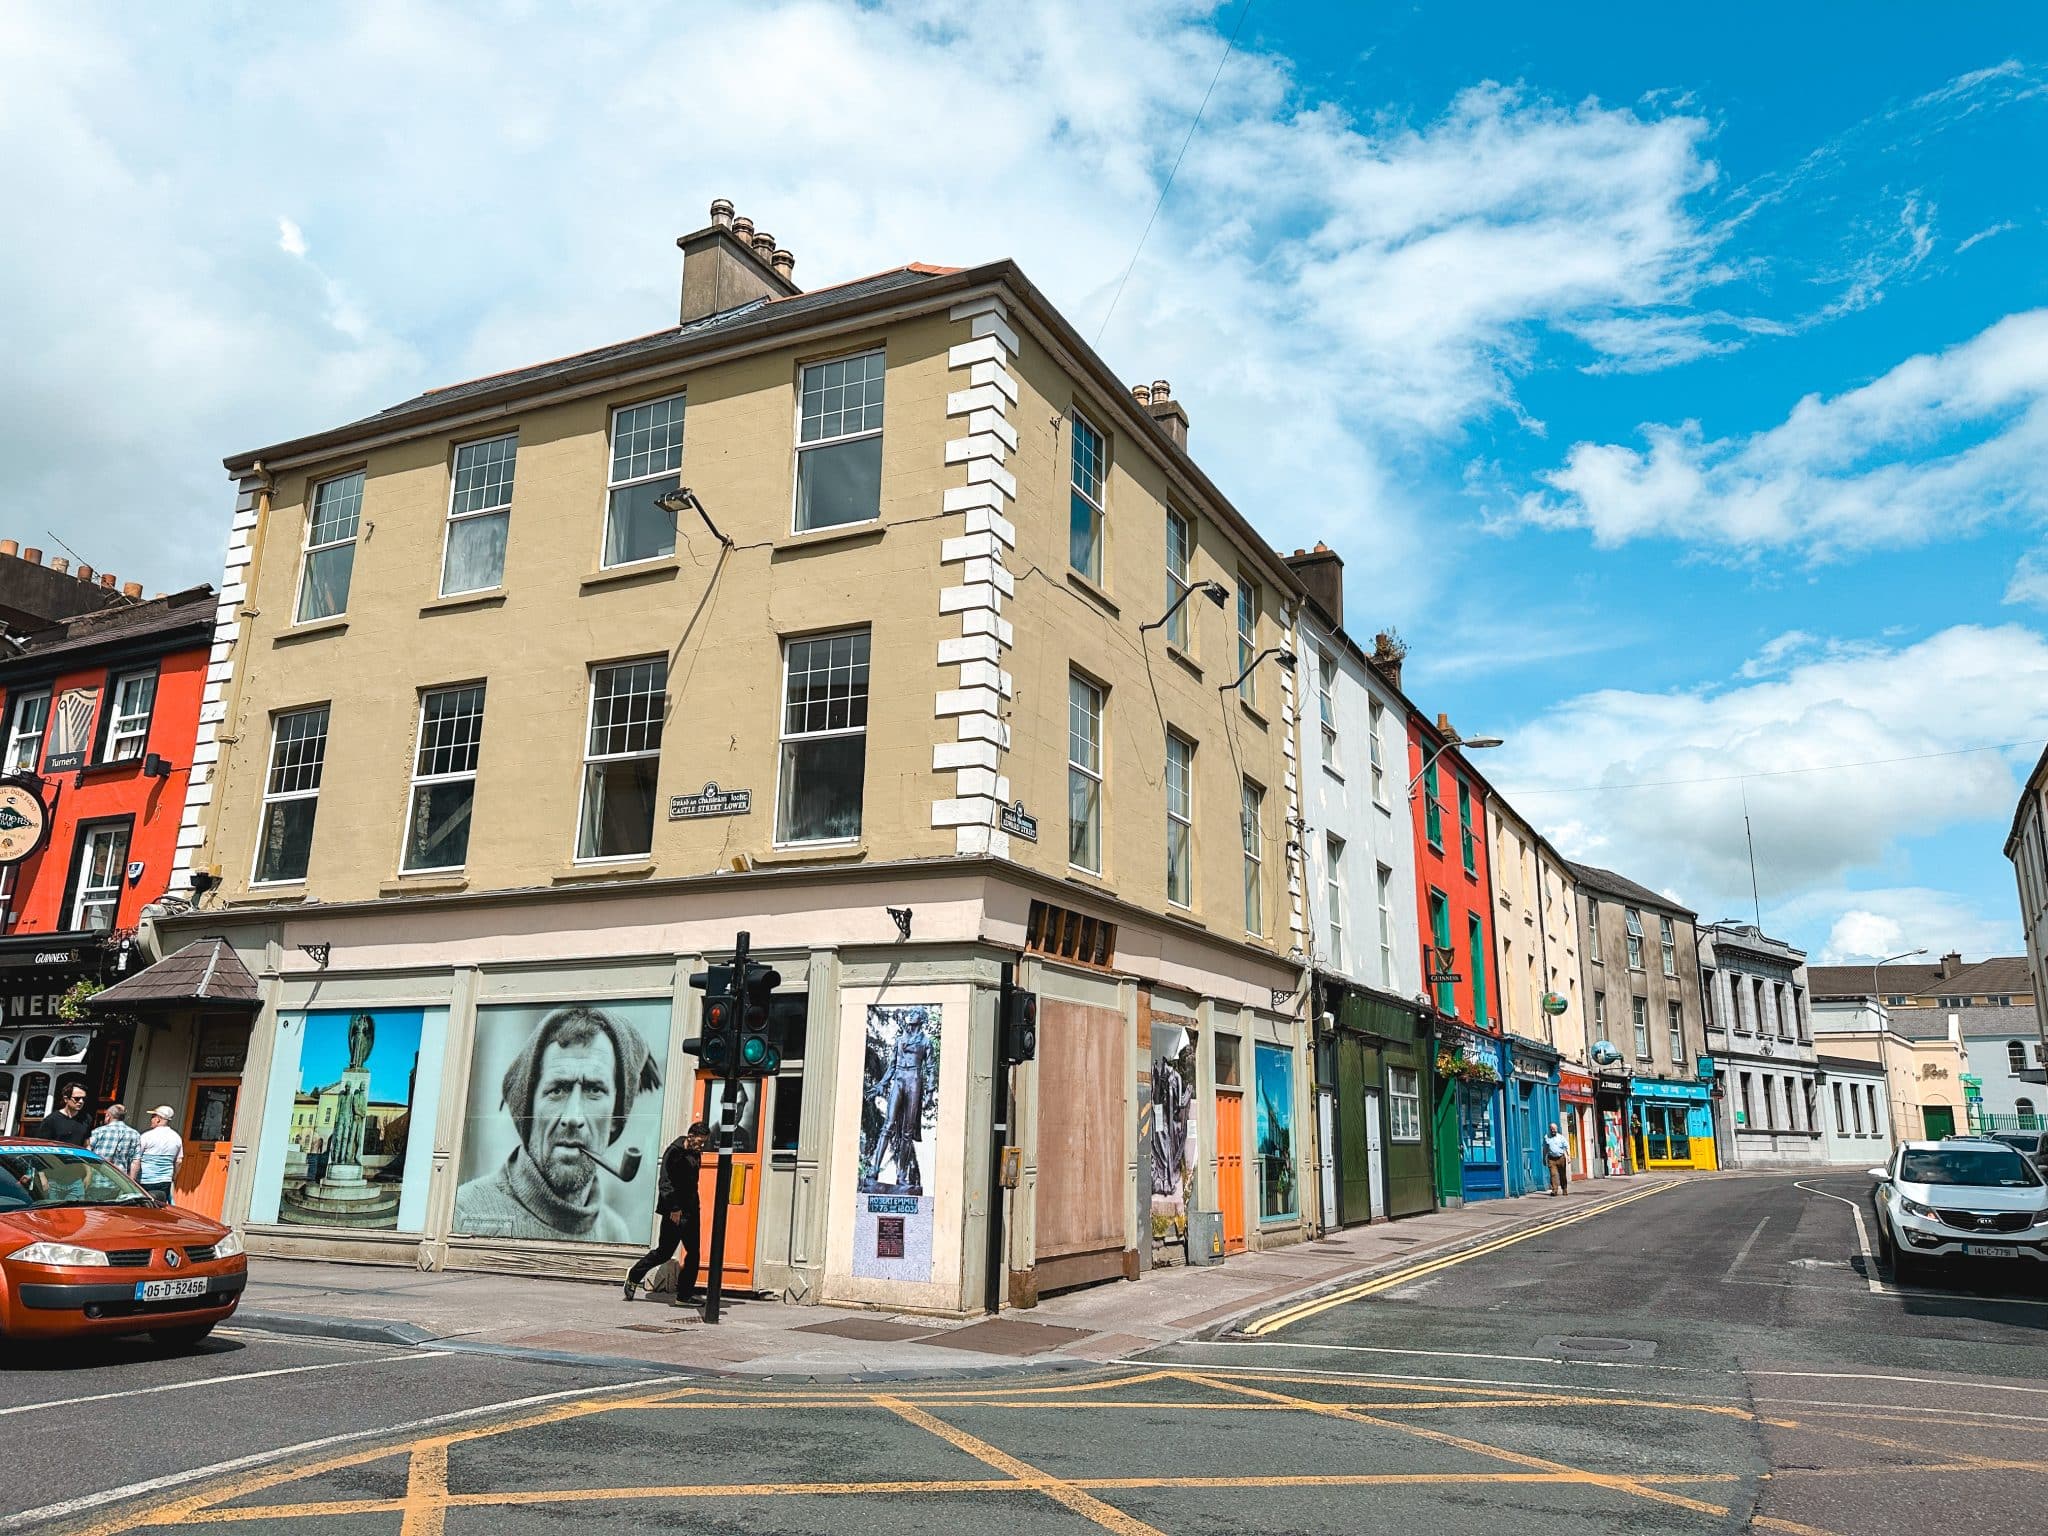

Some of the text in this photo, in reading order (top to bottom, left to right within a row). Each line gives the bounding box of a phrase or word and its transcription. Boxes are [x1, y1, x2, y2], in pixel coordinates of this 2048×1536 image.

[51, 758, 77, 767] Turner's
[672, 801, 747, 815] CASTLE STREET LOWER
[35, 952, 69, 964] GUINNESS
[147, 1282, 203, 1297] 05-D-52456
